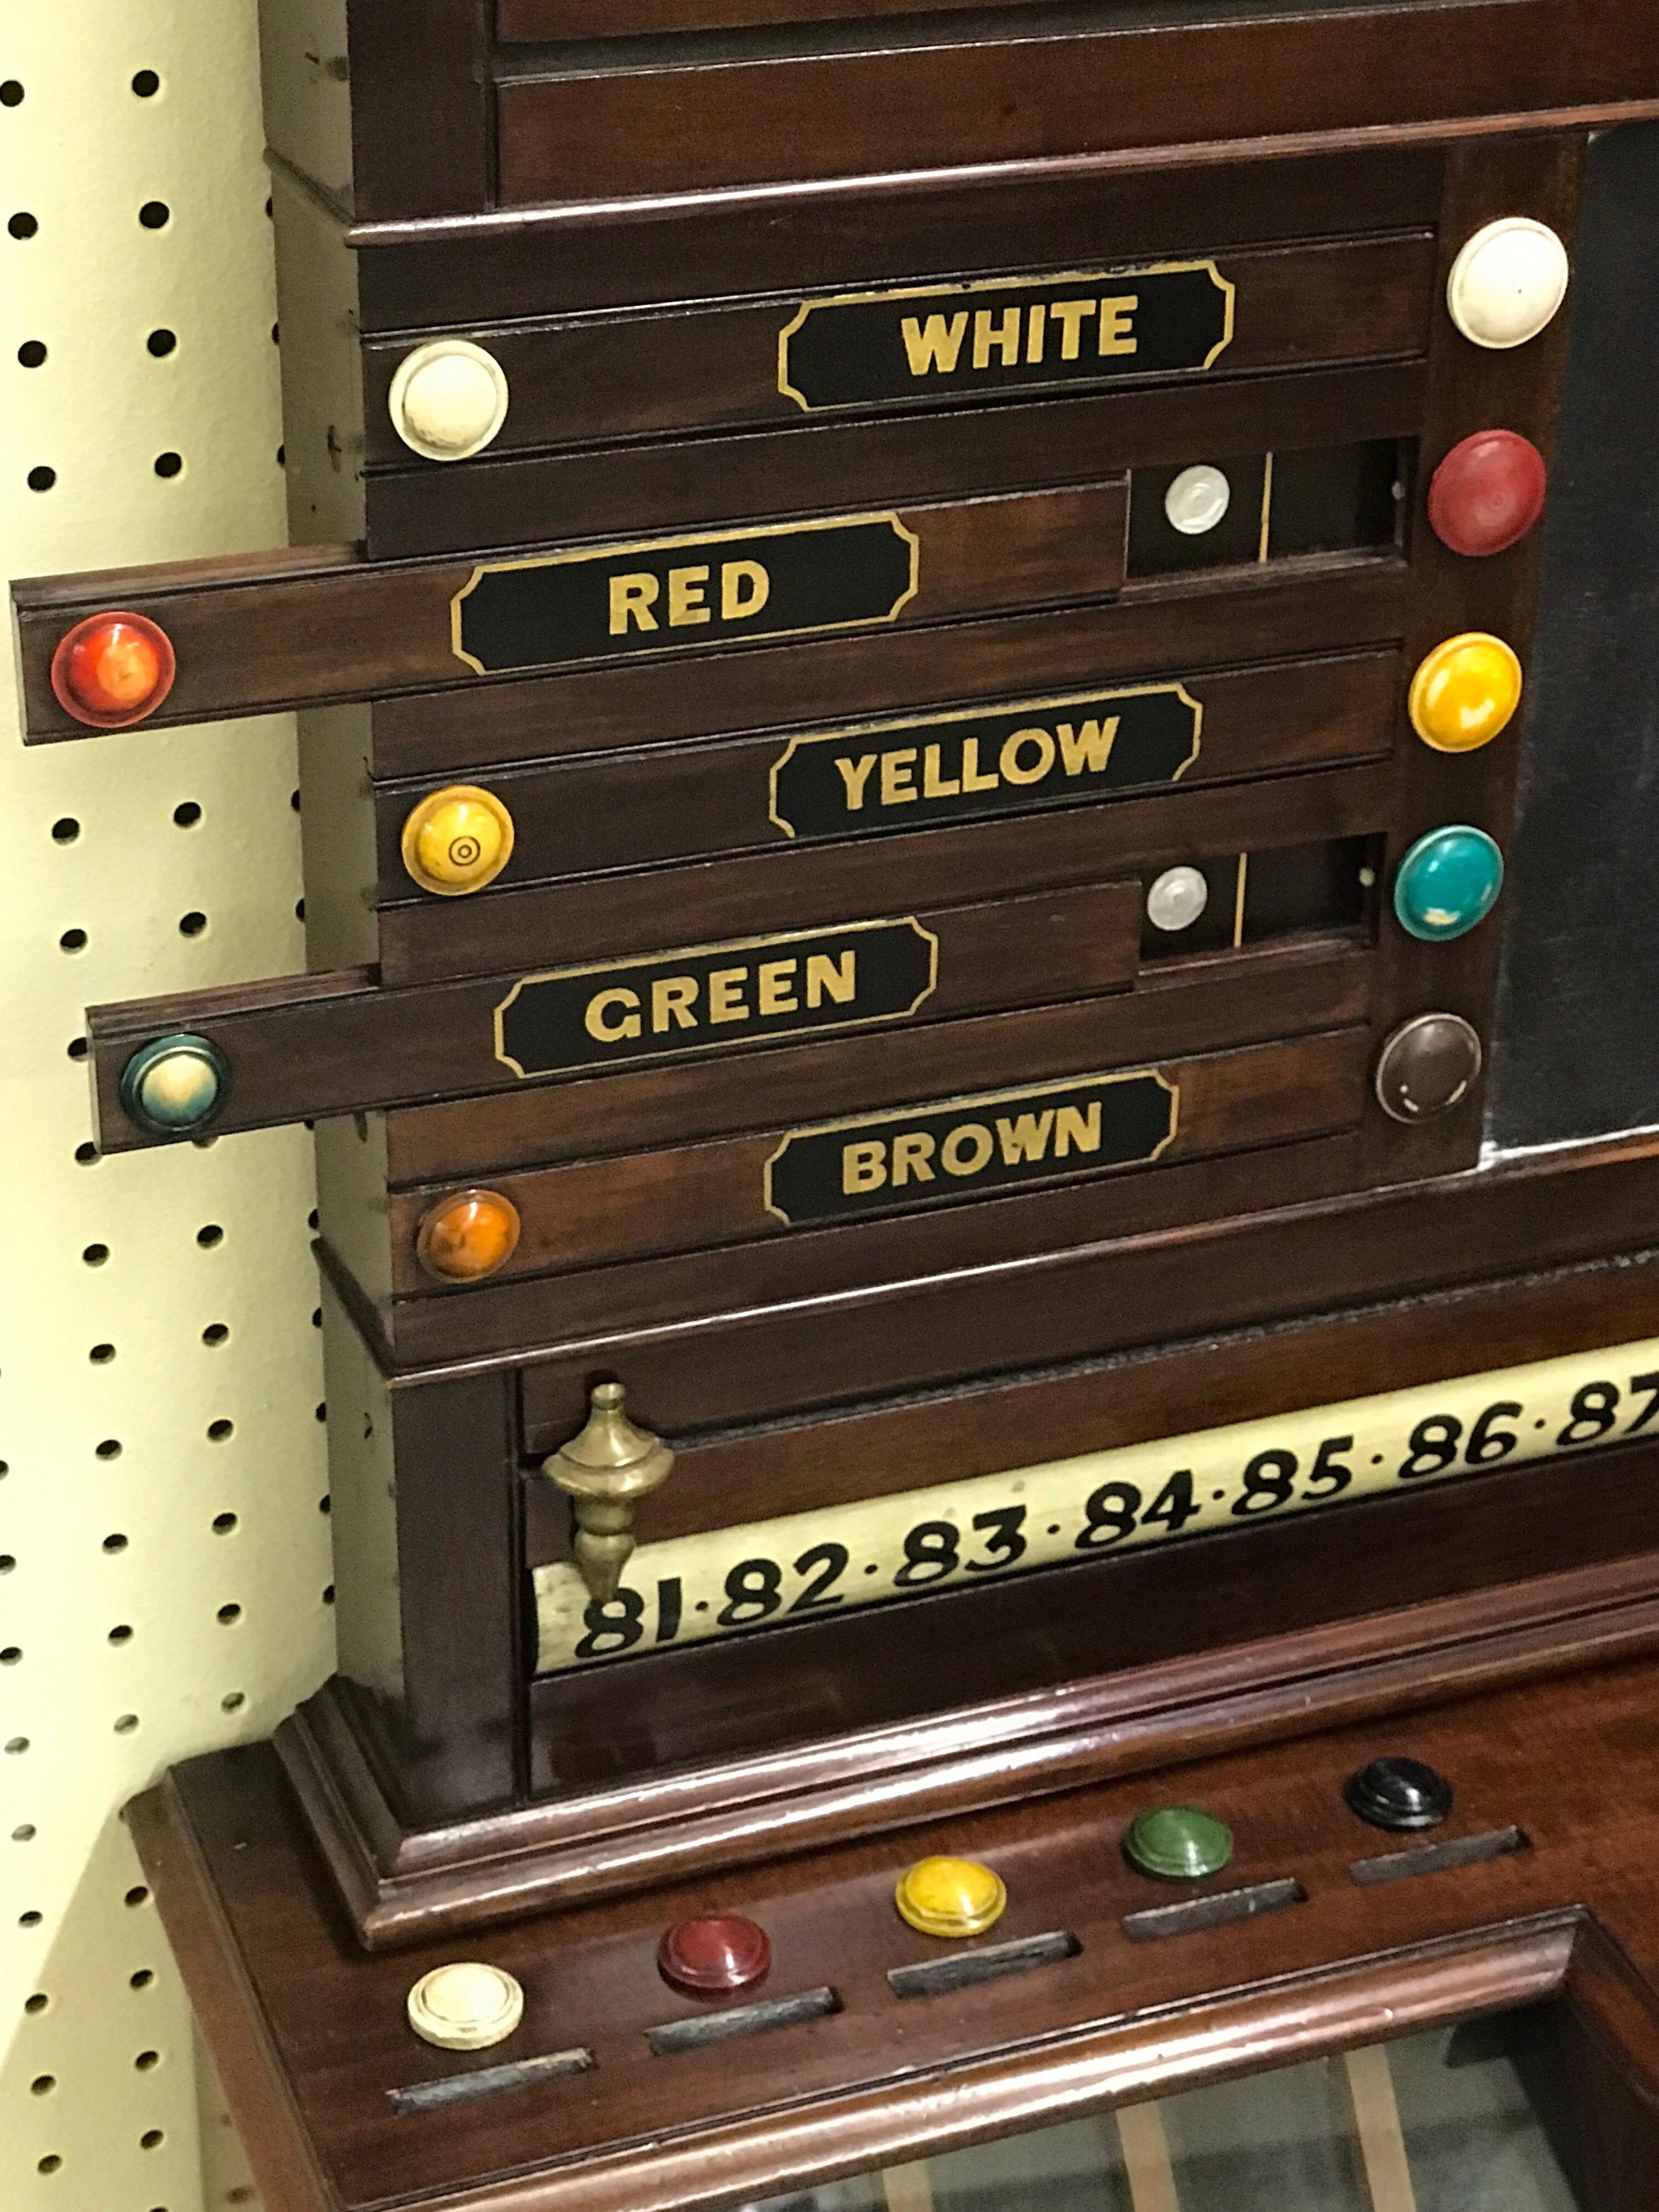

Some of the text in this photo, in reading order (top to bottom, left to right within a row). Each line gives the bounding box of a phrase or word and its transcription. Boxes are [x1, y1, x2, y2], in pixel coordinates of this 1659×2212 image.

[900, 295, 1138, 375] WHITE
[608, 560, 769, 636] RED
[834, 716, 1120, 811] YELLOW
[585, 950, 855, 1042] GREEN
[842, 1100, 1102, 1195] BROWN
[575, 1369, 1659, 1658] 81 82 83 84 85 86 87
